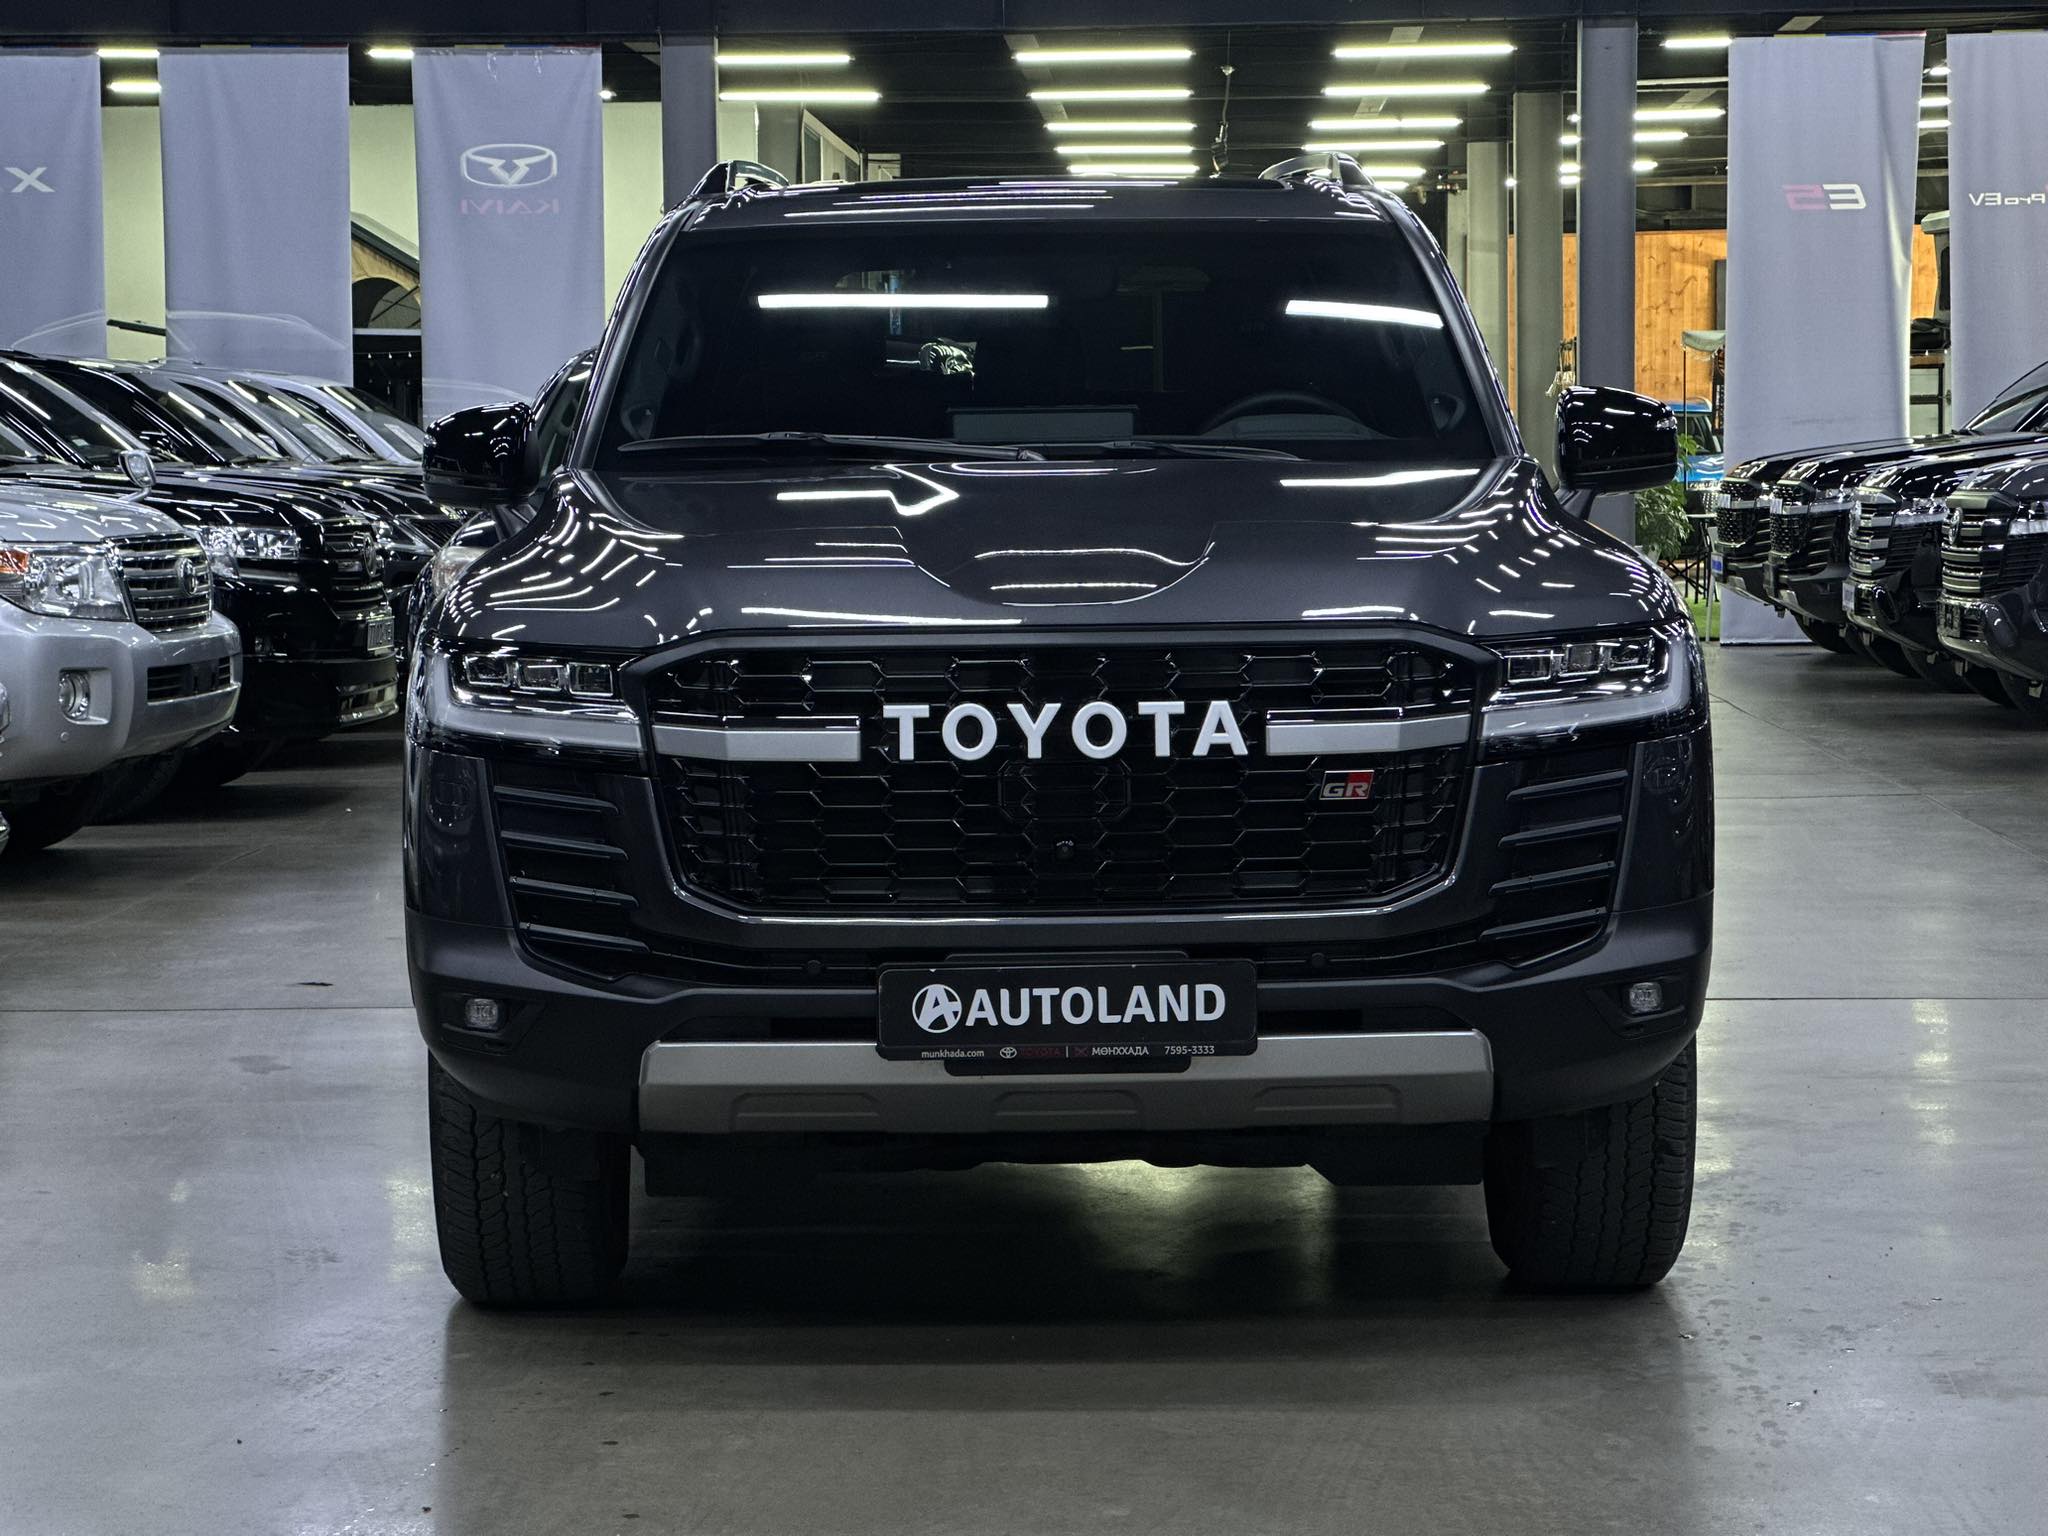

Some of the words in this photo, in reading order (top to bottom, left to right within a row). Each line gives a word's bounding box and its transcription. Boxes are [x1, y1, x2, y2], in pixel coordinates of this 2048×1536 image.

[882, 700, 1249, 761] TOYOTA
[1322, 781, 1370, 798] GR
[965, 983, 1226, 1028] AUTOLAND
[921, 1048, 985, 1059] munkhada.com
[1091, 1045, 1149, 1057] МӨНХХАДА
[1164, 1045, 1215, 1056] 7595-3333
